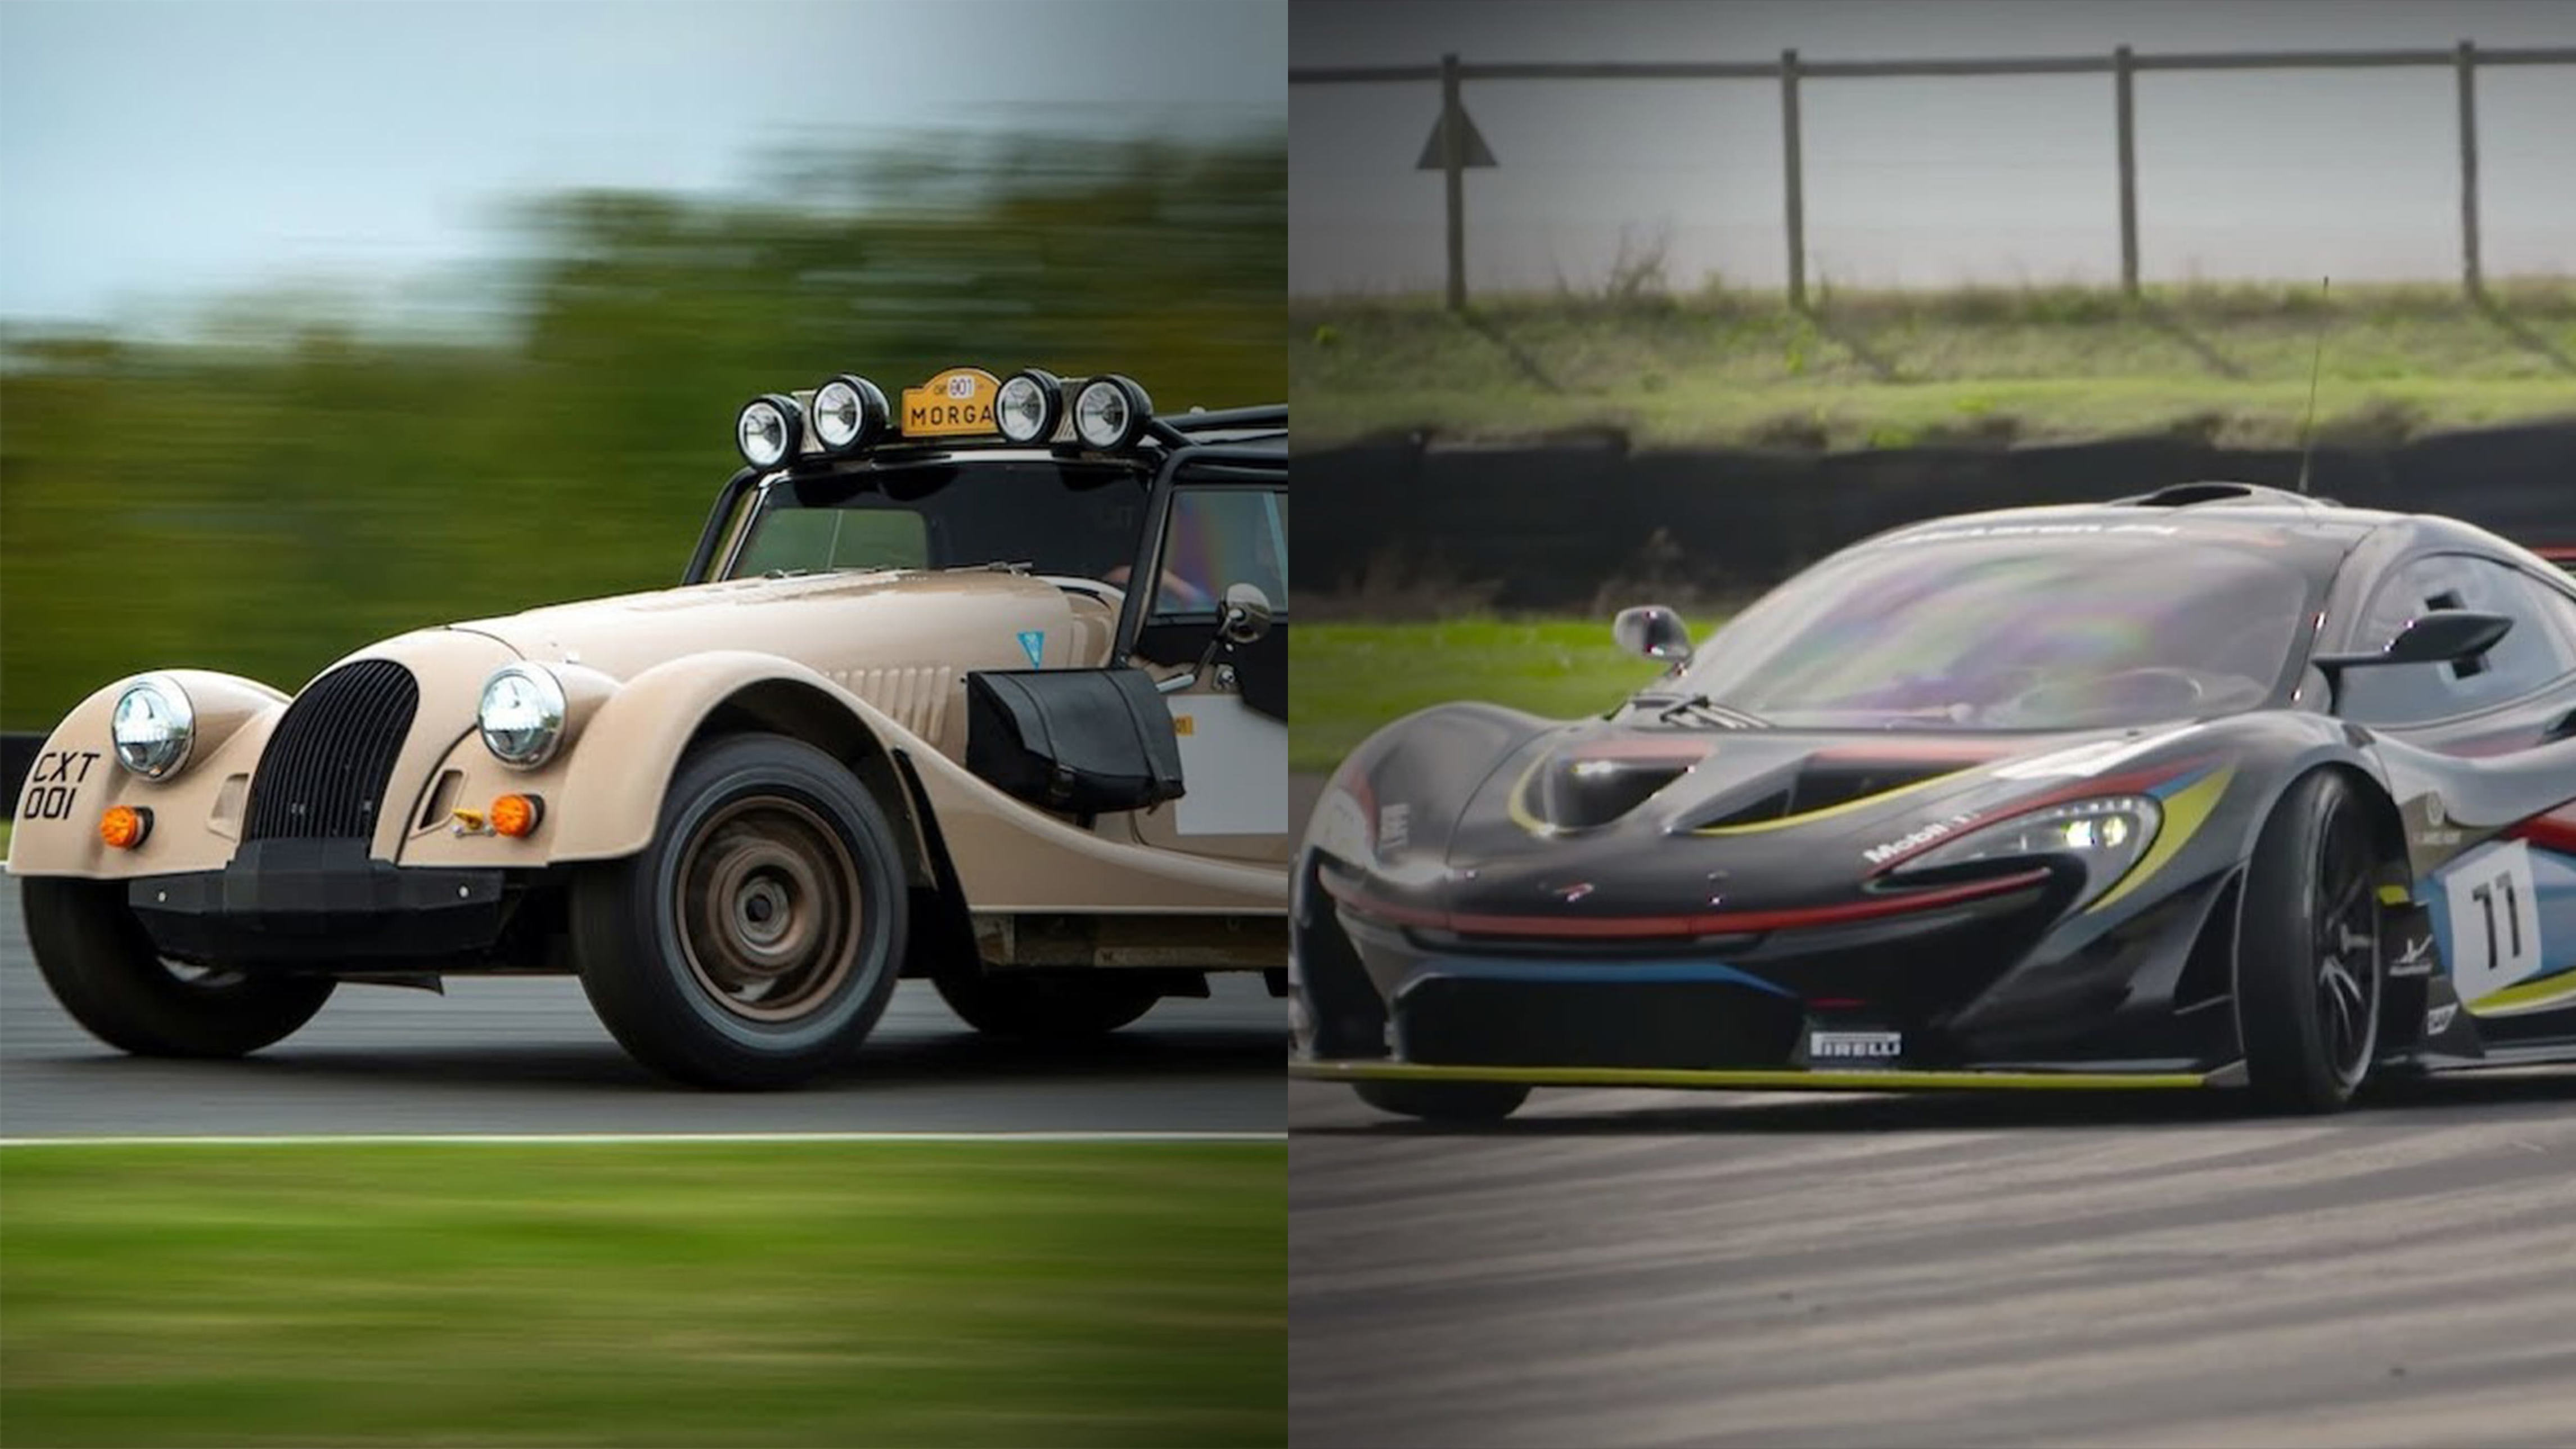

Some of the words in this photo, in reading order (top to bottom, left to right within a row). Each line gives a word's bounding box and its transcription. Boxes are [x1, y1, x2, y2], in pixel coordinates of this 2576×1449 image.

[32, 752, 101, 783] CXT
[23, 786, 77, 820] 001
[1862, 823, 1950, 863] Mobil
[2473, 870, 2521, 969] 11
[1811, 1032, 1902, 1056] PIRELLI
